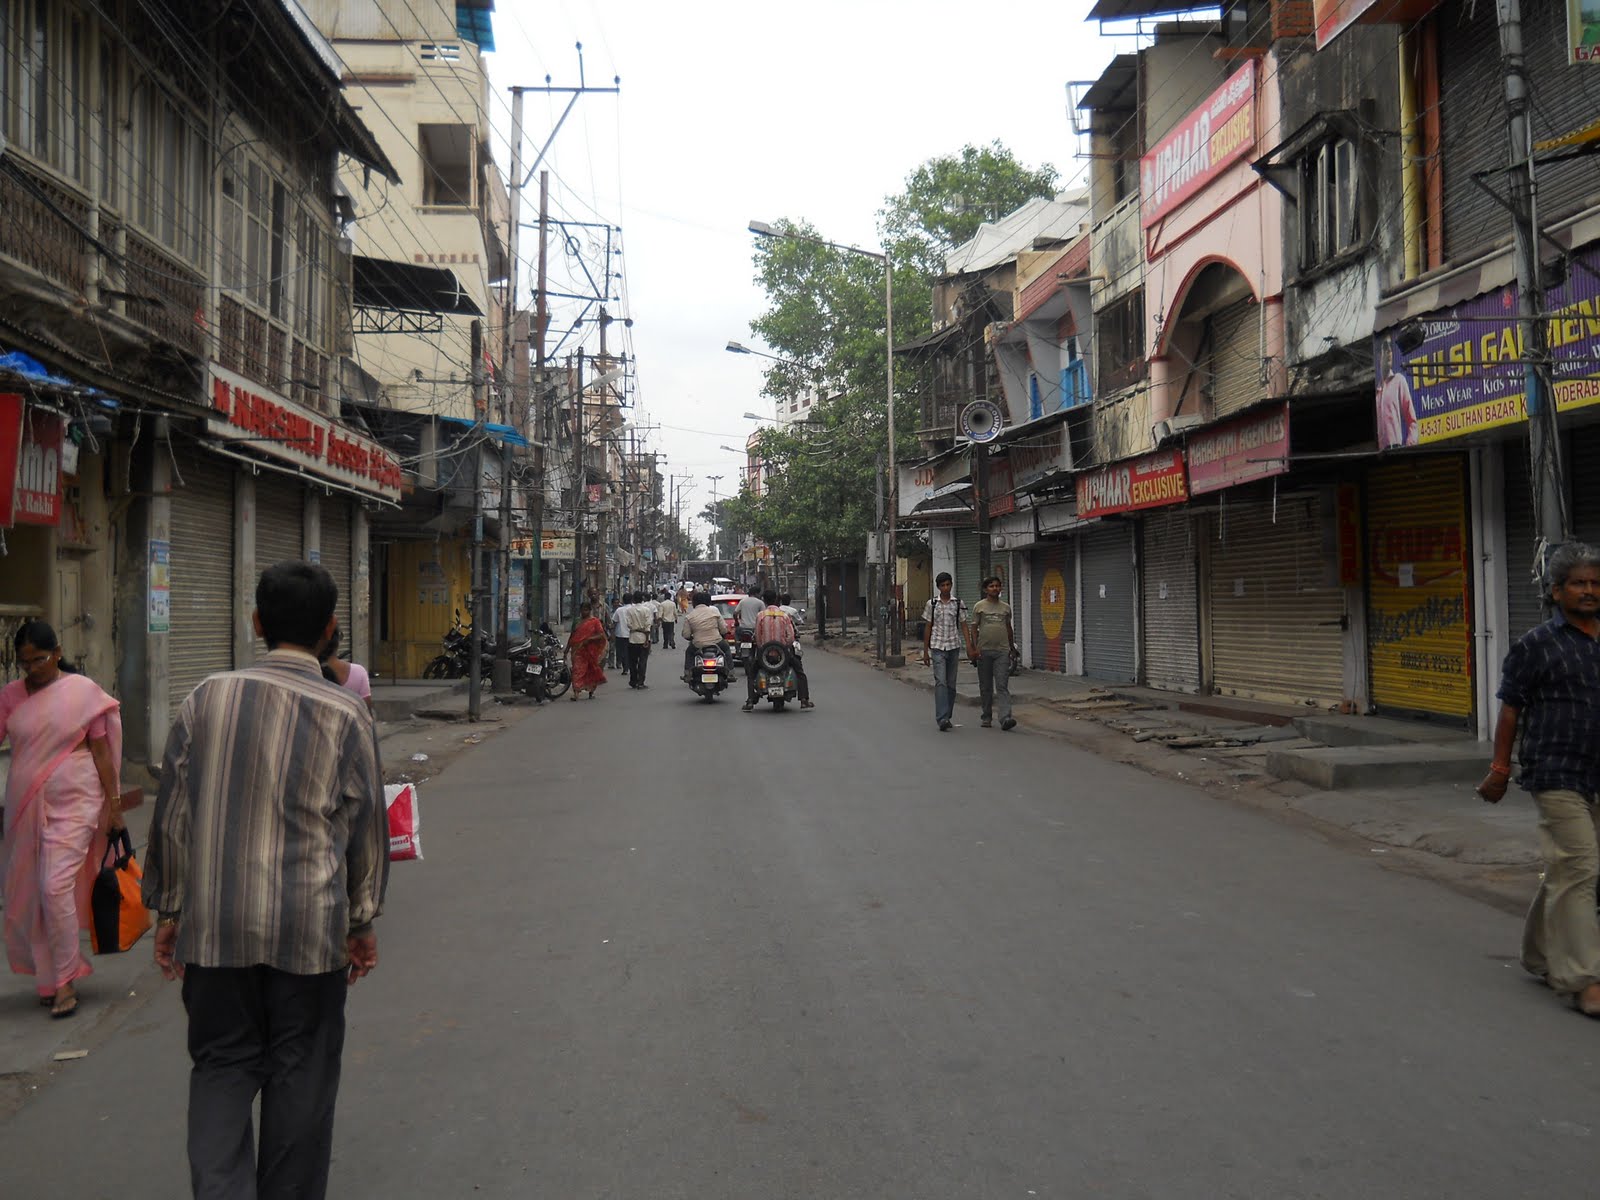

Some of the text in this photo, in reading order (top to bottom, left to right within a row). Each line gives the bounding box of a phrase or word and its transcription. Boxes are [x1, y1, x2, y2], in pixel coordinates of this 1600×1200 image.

[1154, 104, 1250, 205] UPHAAR EXCLUSIVE
[1409, 340, 1472, 390] TULSI
[988, 406, 1000, 434] SOUND
[1446, 408, 1483, 431] SULTHAN
[1555, 379, 1600, 404] YDERAB
[1084, 466, 1185, 510] UPHAAR EXCLUSIVE
